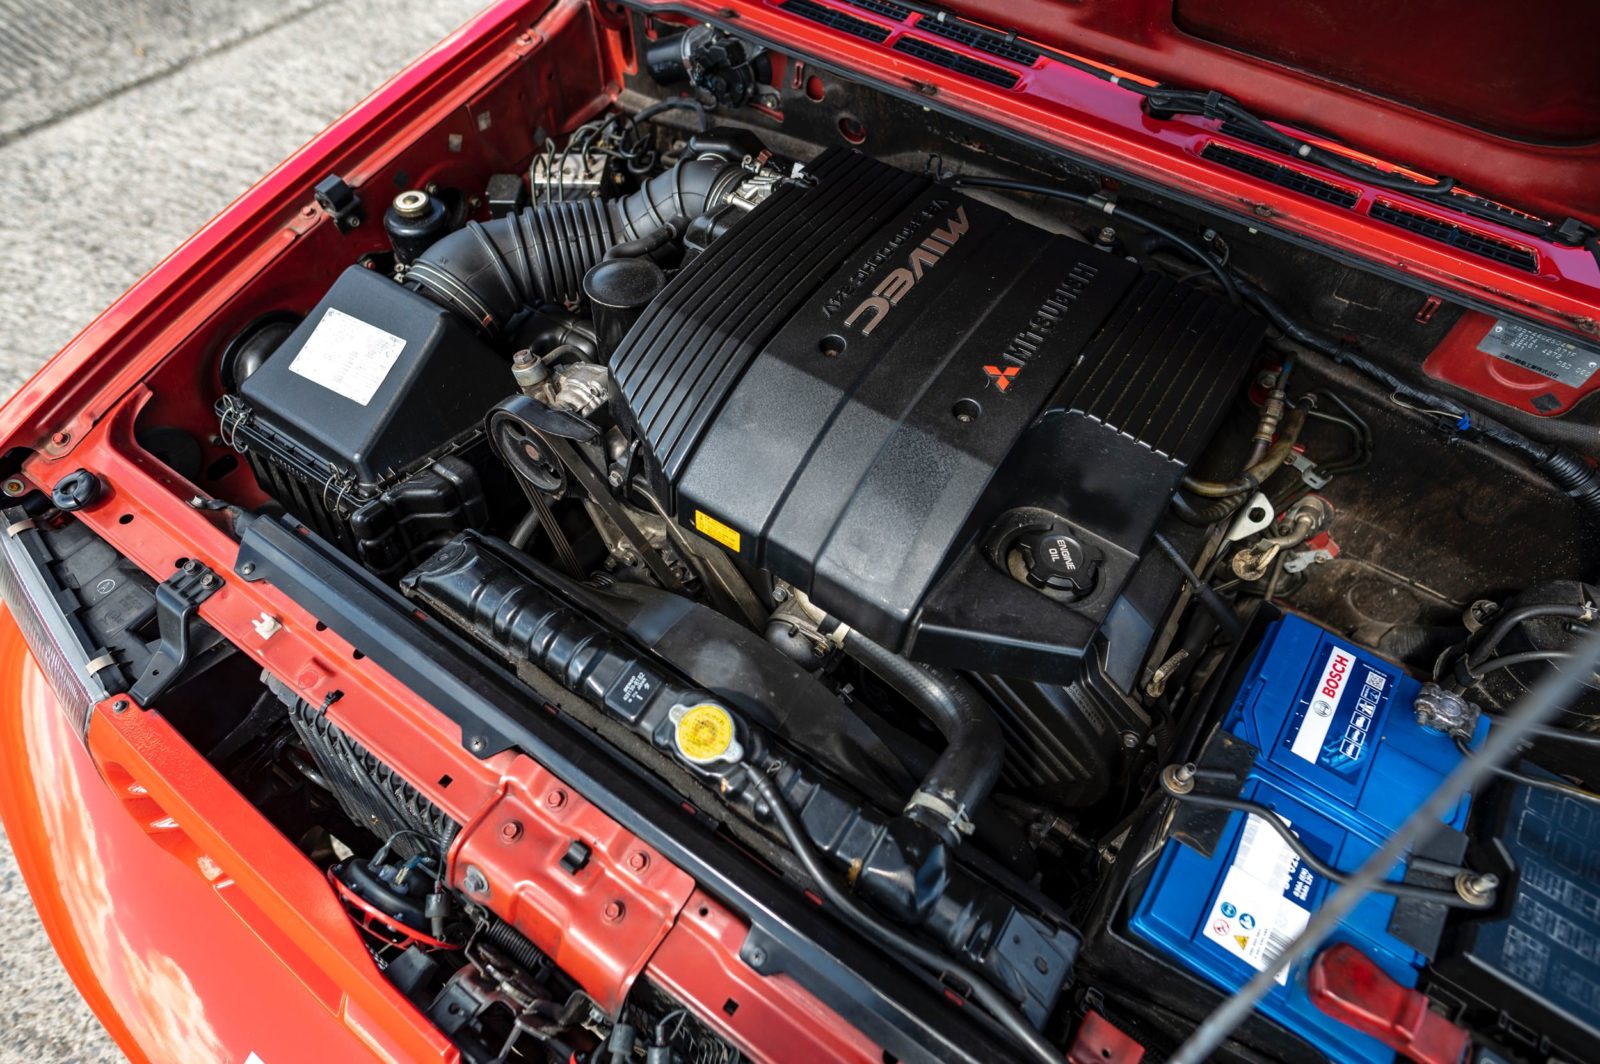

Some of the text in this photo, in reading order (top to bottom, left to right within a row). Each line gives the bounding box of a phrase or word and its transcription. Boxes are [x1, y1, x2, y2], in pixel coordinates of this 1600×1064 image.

[844, 205, 970, 336] MIVEC
[1002, 262, 1099, 367] MITSUBISHI
[1048, 548, 1060, 563] OIL
[1056, 539, 1076, 570] ENGINE
[1322, 654, 1349, 699] BOSCH
